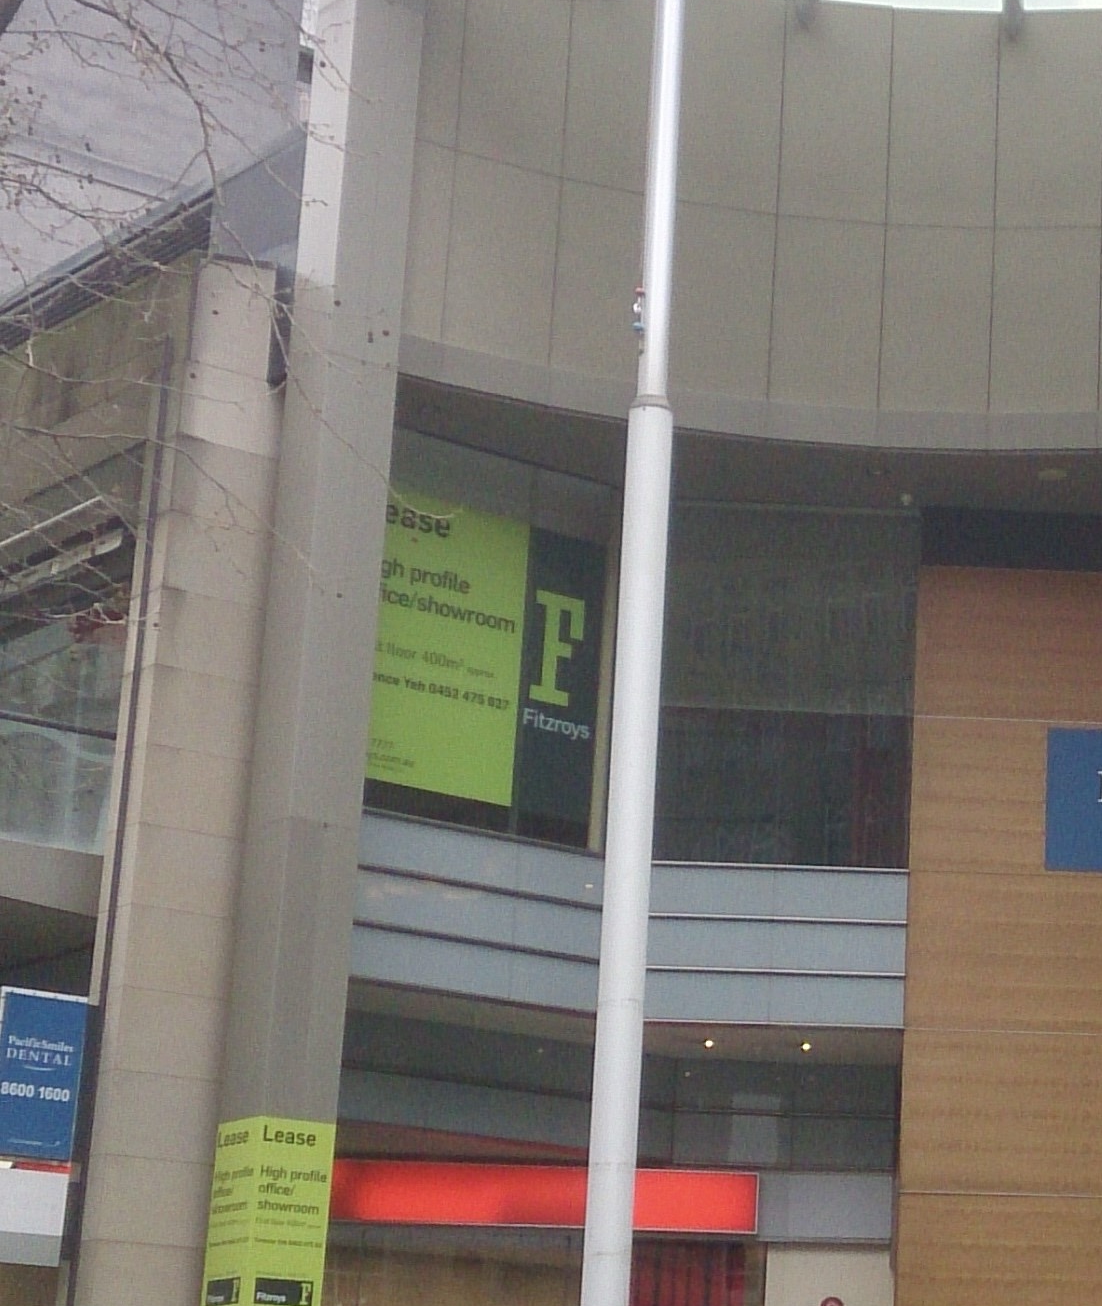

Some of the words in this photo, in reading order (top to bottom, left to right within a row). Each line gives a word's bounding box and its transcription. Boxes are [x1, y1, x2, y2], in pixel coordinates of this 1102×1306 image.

[385, 503, 451, 538] ease
[380, 558, 405, 579] gh
[410, 566, 471, 594] profile
[380, 582, 516, 634] ice/showroom
[528, 589, 585, 707] F
[522, 706, 591, 740] Fitzroys
[6, 1047, 72, 1067] DENTAL
[1, 1081, 35, 1098] 8600
[38, 1086, 70, 1102] 1600
[262, 1124, 317, 1147] Lease
[260, 1165, 287, 1181] High
[290, 1170, 328, 1183] profile
[257, 1199, 320, 1215] showroom
